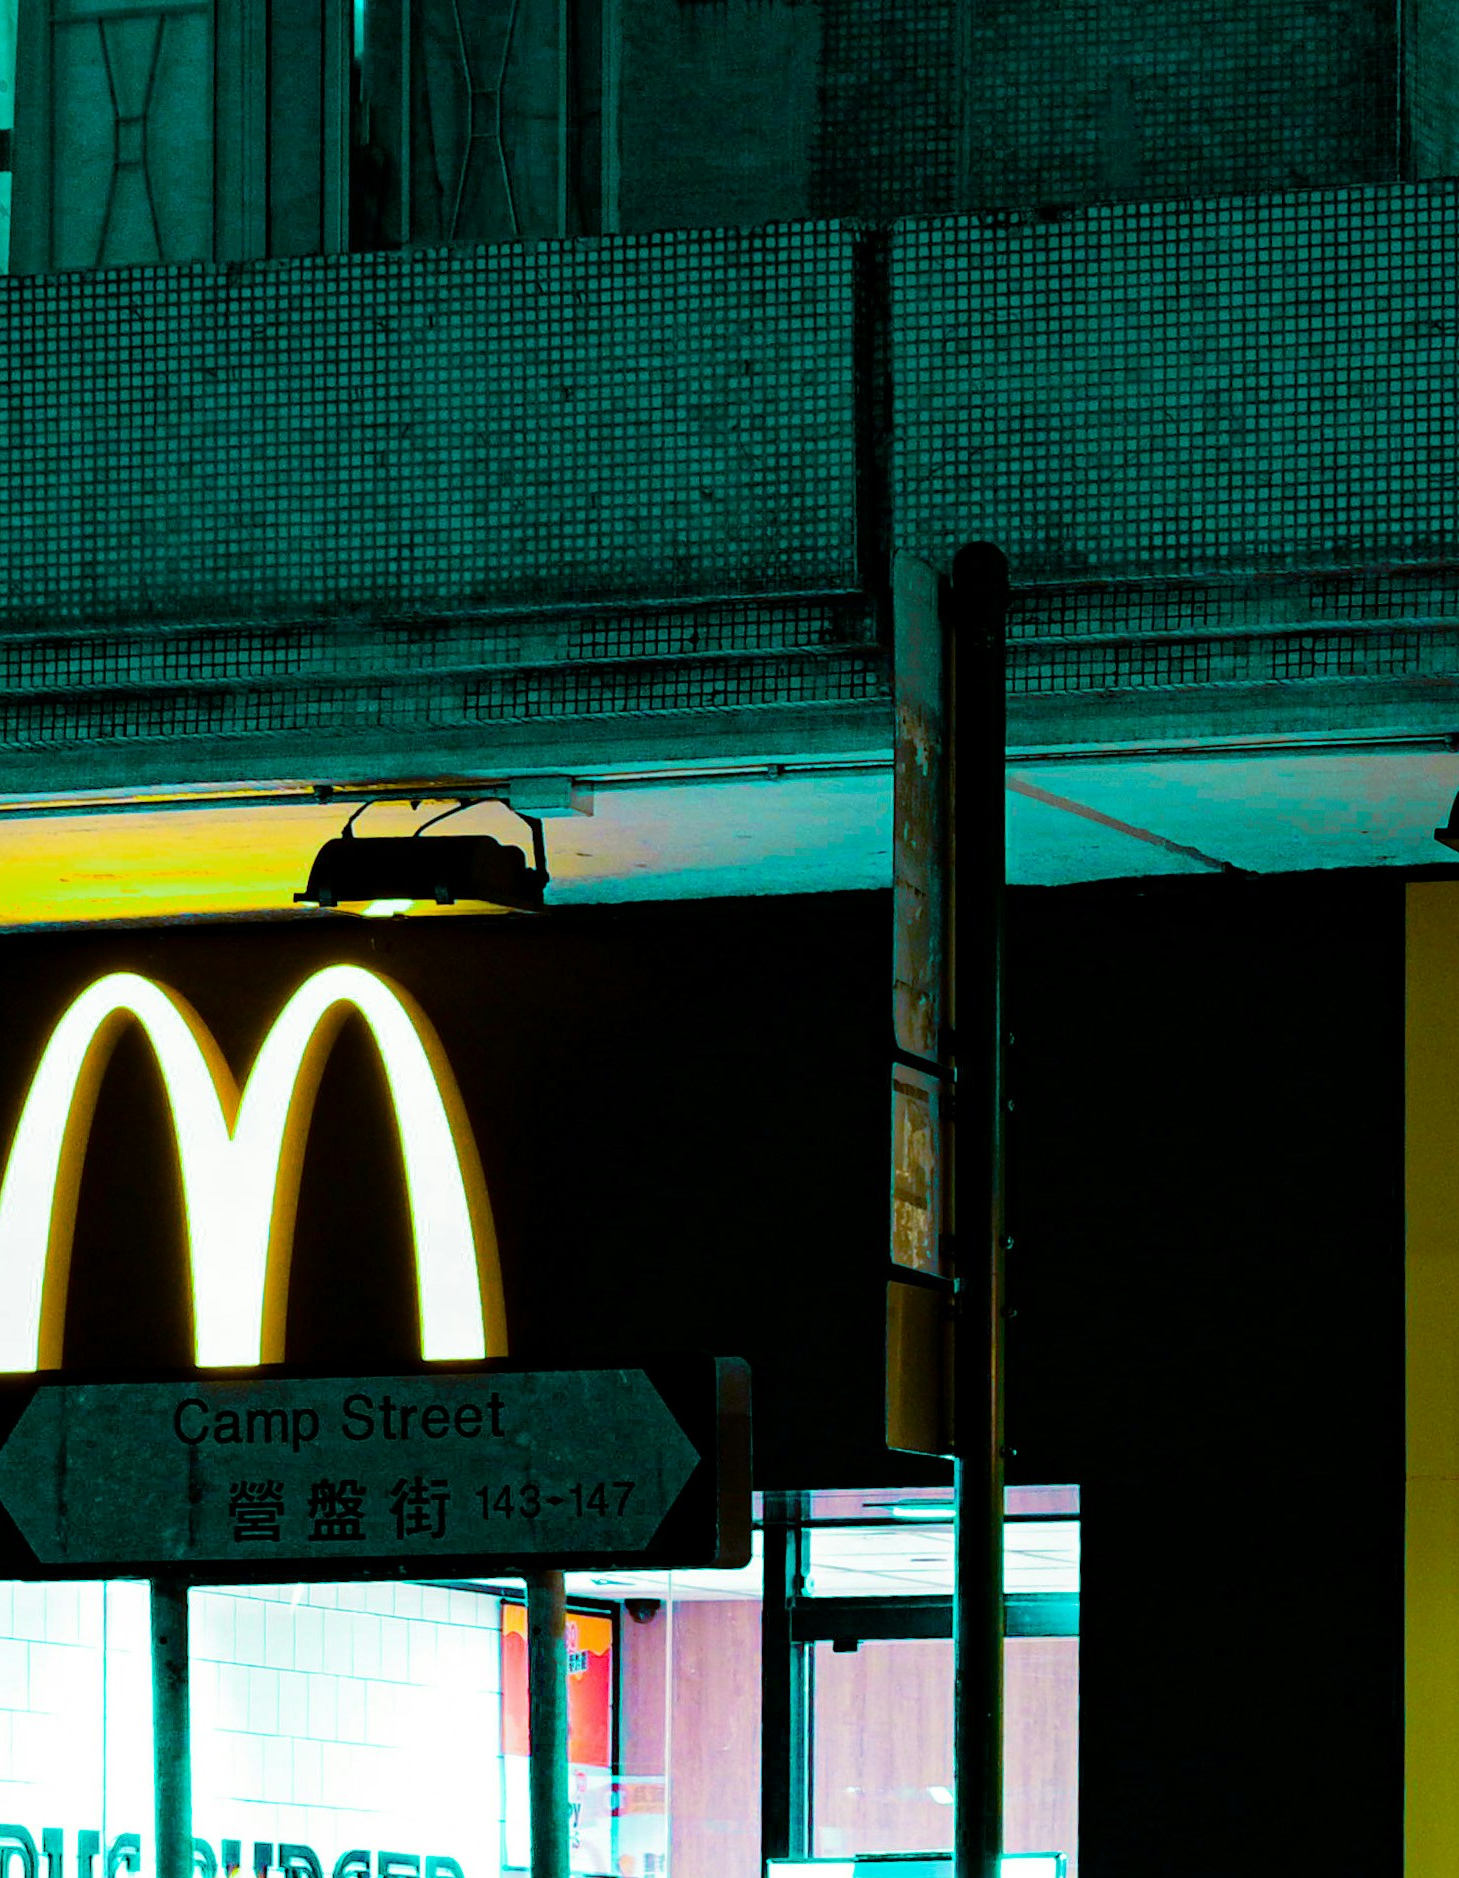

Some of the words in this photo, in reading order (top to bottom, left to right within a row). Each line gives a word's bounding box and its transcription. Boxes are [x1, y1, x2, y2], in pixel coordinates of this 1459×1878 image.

[173, 1398, 321, 1453] Camp
[341, 1391, 506, 1441] Street
[227, 1479, 448, 1542] 營盤街
